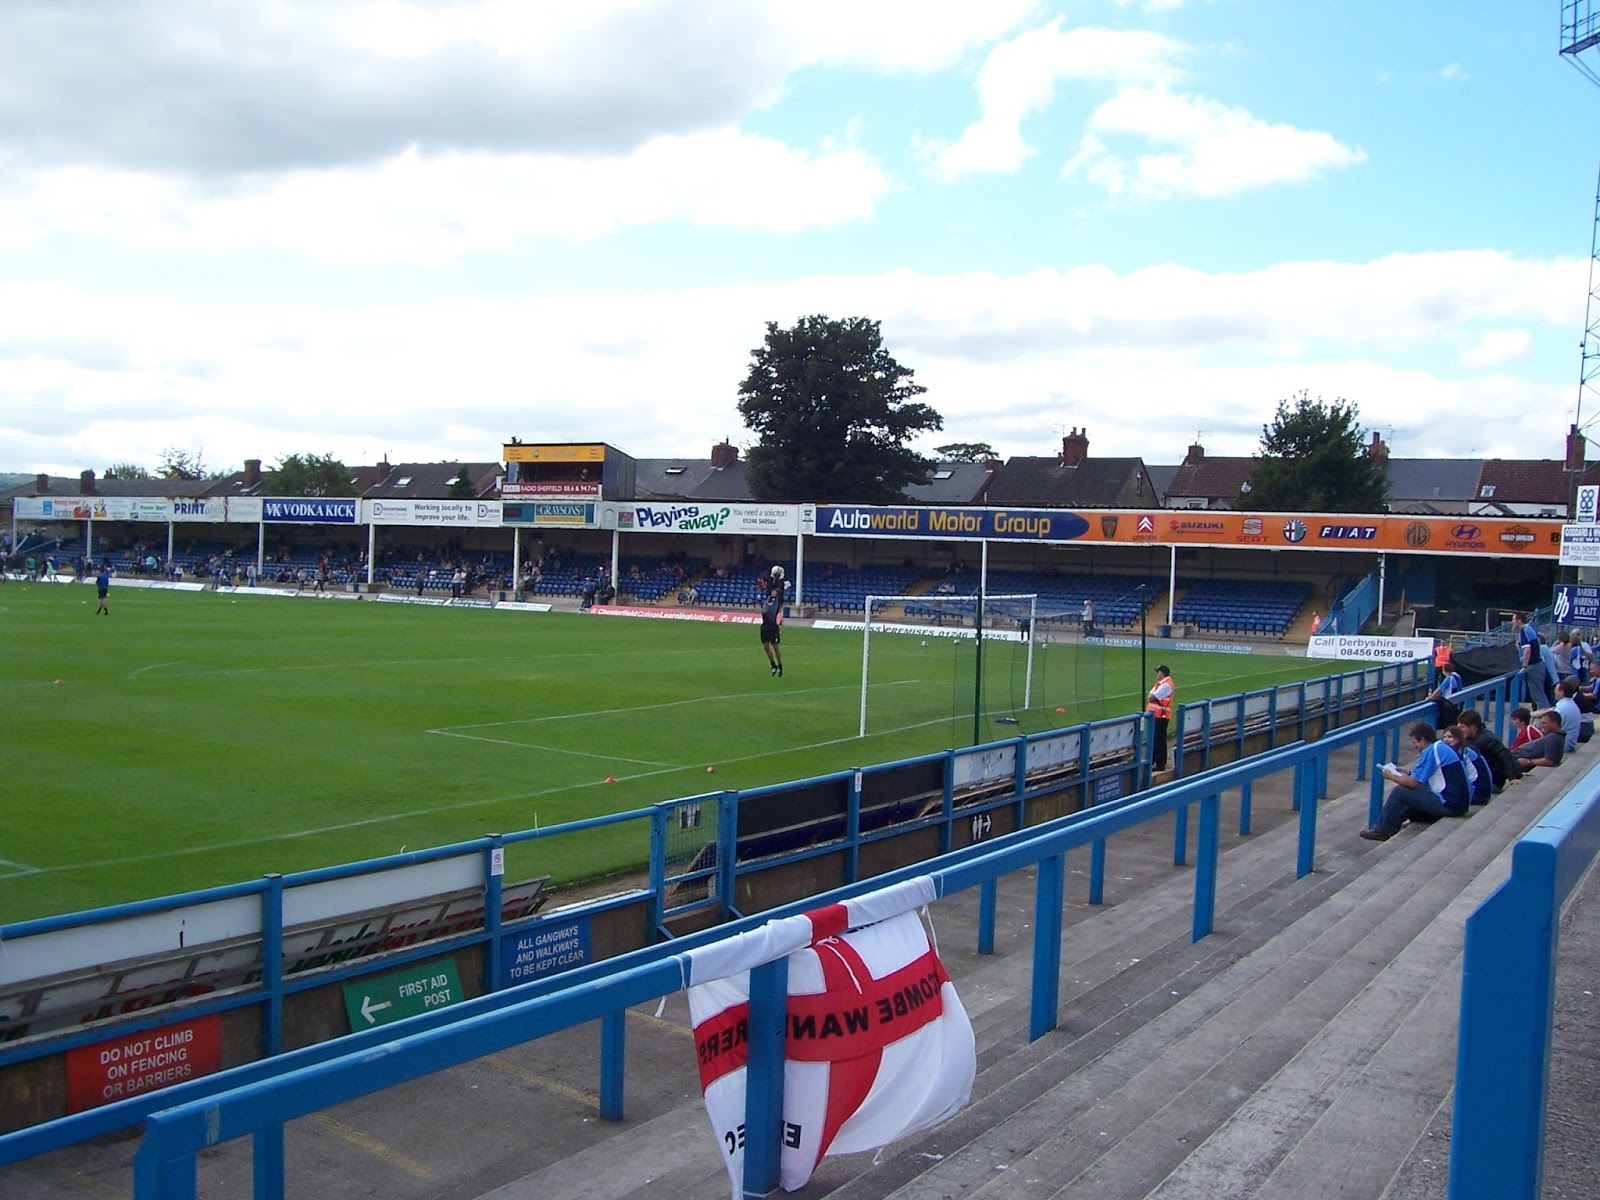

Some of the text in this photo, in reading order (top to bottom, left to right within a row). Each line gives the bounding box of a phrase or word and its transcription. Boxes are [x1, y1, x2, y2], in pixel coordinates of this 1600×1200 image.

[265, 503, 282, 517] VK
[283, 503, 324, 517] VODKA
[325, 504, 354, 517] KICK
[414, 504, 440, 512] Working
[441, 504, 463, 512] locally
[540, 505, 580, 515] GRAYSONS
[733, 508, 743, 516] You
[744, 508, 758, 516] need
[764, 509, 787, 517] solicitor!
[636, 506, 699, 528] Playing
[679, 507, 730, 531] away?
[830, 509, 919, 530] Autoworld
[929, 510, 982, 532] Motor
[994, 512, 1051, 538] Group
[1236, 535, 1270, 543] SEAT
[1321, 527, 1375, 538] FIAT
[1406, 523, 1428, 545] MG
[1577, 588, 1597, 597] BARBER
[1574, 597, 1599, 606] HARRISON
[598, 608, 637, 617] Chesterfield
[660, 612, 692, 620] Learning
[1579, 607, 1597, 616] PLATT
[887, 626, 935, 636] PREMISES
[938, 629, 968, 639] 01246
[1314, 638, 1334, 646] Call
[1339, 638, 1397, 648] Derbyshire
[1374, 649, 1392, 657] 058
[1395, 650, 1414, 658] 058
[517, 926, 579, 950] ALL GANGWAYS
[516, 938, 579, 964] AND WALKWAYS
[510, 949, 584, 979] TO BE KEPT CLEAR
[399, 974, 448, 997] FIRST AID
[424, 989, 451, 1008] POST
[101, 1029, 194, 1065] DO NOT CLIMB
[108, 1048, 188, 1080] ON FENCING
[103, 1063, 192, 1099] OR BARRIERS
